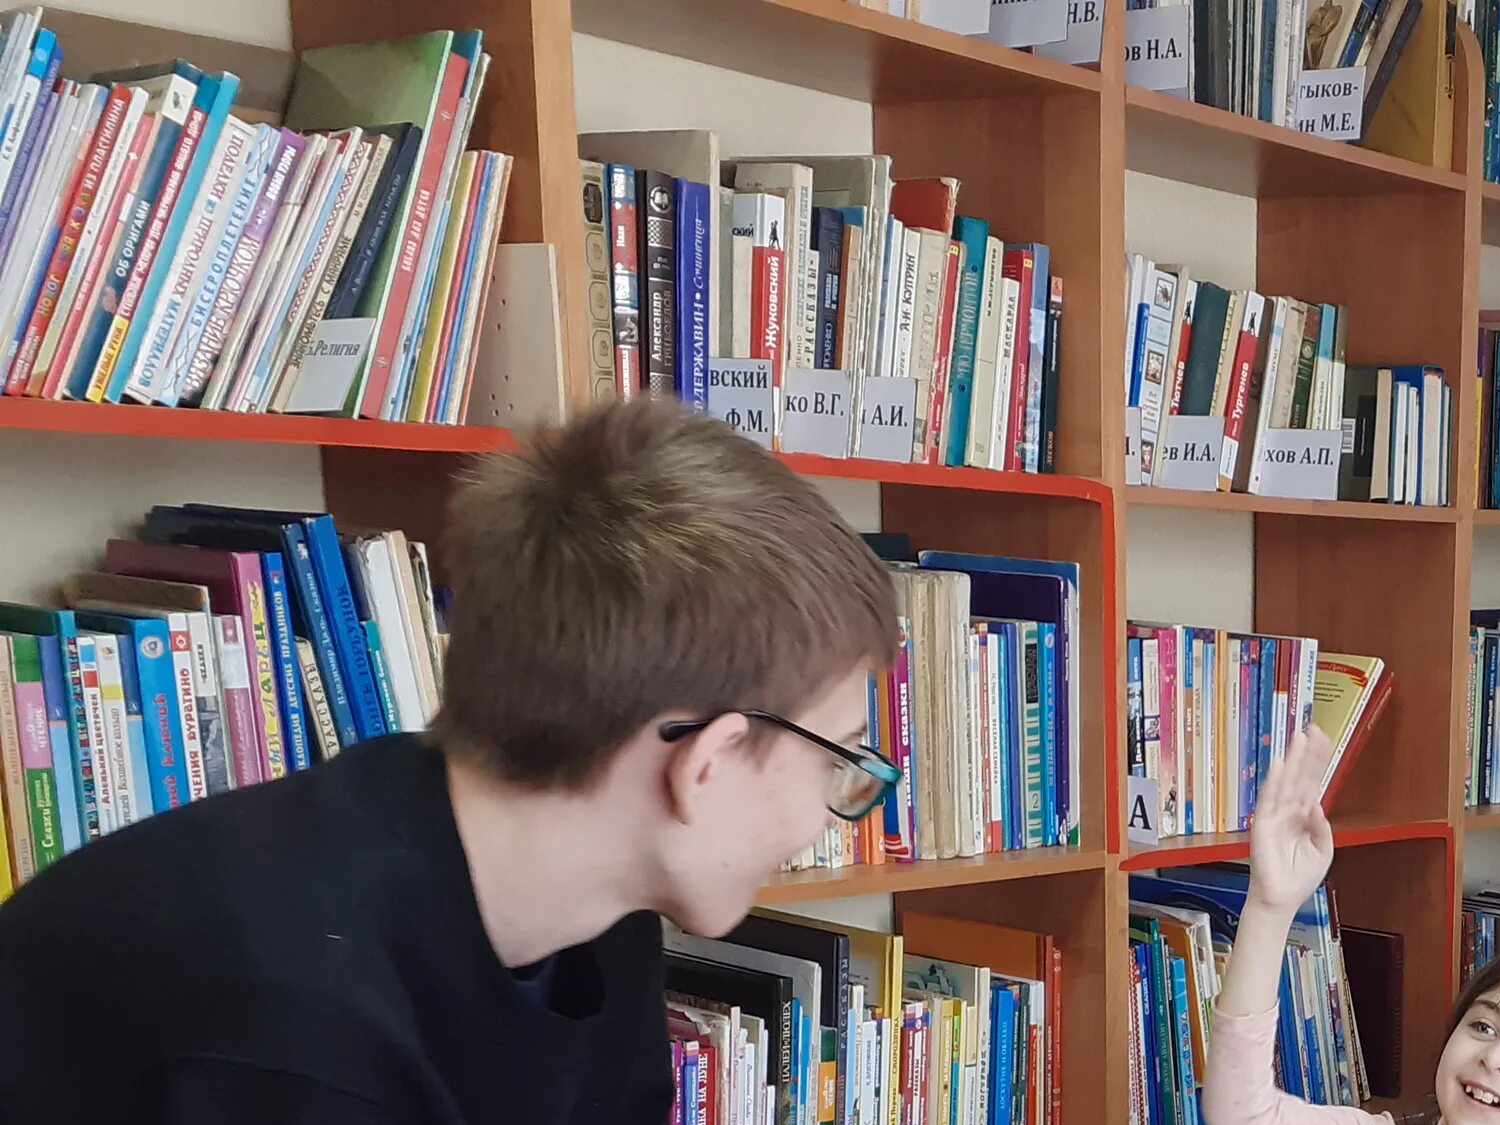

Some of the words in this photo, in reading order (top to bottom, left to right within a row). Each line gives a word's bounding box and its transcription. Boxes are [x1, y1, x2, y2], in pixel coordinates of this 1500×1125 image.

[1146, 39, 1183, 61] Н.А.
[91, 99, 125, 173] ПЛАСТИЛИНА
[1321, 113, 1355, 133] М.Е.
[213, 134, 246, 197] ПОДЕЛКИ
[116, 259, 129, 279] ОБ
[124, 200, 151, 257] ОРИГАМИ
[174, 216, 213, 300] ПРИРОДНЫХ
[193, 178, 256, 329] БИСЕРОПЛЕТЕНИЕ
[187, 314, 227, 391] ВЯЗАНИЕ
[215, 234, 261, 317] КРЮЧКОМ
[266, 174, 285, 201] НОВЫЕ
[276, 146, 297, 177] УЗОРЫ
[903, 252, 916, 305] КУПРИН
[291, 300, 326, 370] ЗНАКОМЬТЕСЬ
[320, 286, 330, 296] С
[327, 235, 352, 286] МАКРАМЕ
[652, 292, 663, 361] Александр
[766, 256, 780, 348] Жуковский
[807, 268, 816, 354] РАССКАЗЫ
[140, 300, 182, 388] МАТЕРИАЛОВ
[694, 303, 703, 397] ДЕРЖАВИН
[710, 365, 768, 389] вский
[1172, 362, 1185, 409] Тютчев
[1232, 362, 1249, 420] Тургенев
[726, 409, 768, 433] Ф.М.
[786, 394, 809, 412] ко
[814, 392, 843, 416] В.Г.
[871, 405, 908, 427] А.И.
[1182, 443, 1215, 462] И.А.
[1301, 447, 1334, 466] А.П.
[274, 591, 294, 658] ПРАЗДНИКОВ
[178, 668, 198, 741] БУРАТИНО
[283, 664, 301, 709] ДЕТСКИХ
[305, 662, 339, 750] РАССКАЗЫ
[90, 694, 105, 747] цветочек
[110, 708, 121, 740] кольцо
[900, 683, 909, 745] сказки
[100, 750, 111, 805] Аленький
[114, 741, 129, 791] Волшебное
[1135, 742, 1143, 762] Две
[1031, 793, 1039, 809] 2
[1129, 795, 1151, 829] А
[41, 809, 54, 848] Сказки
[698, 1086, 707, 1102] НА
[699, 1053, 708, 1084] ЛУНЕ
